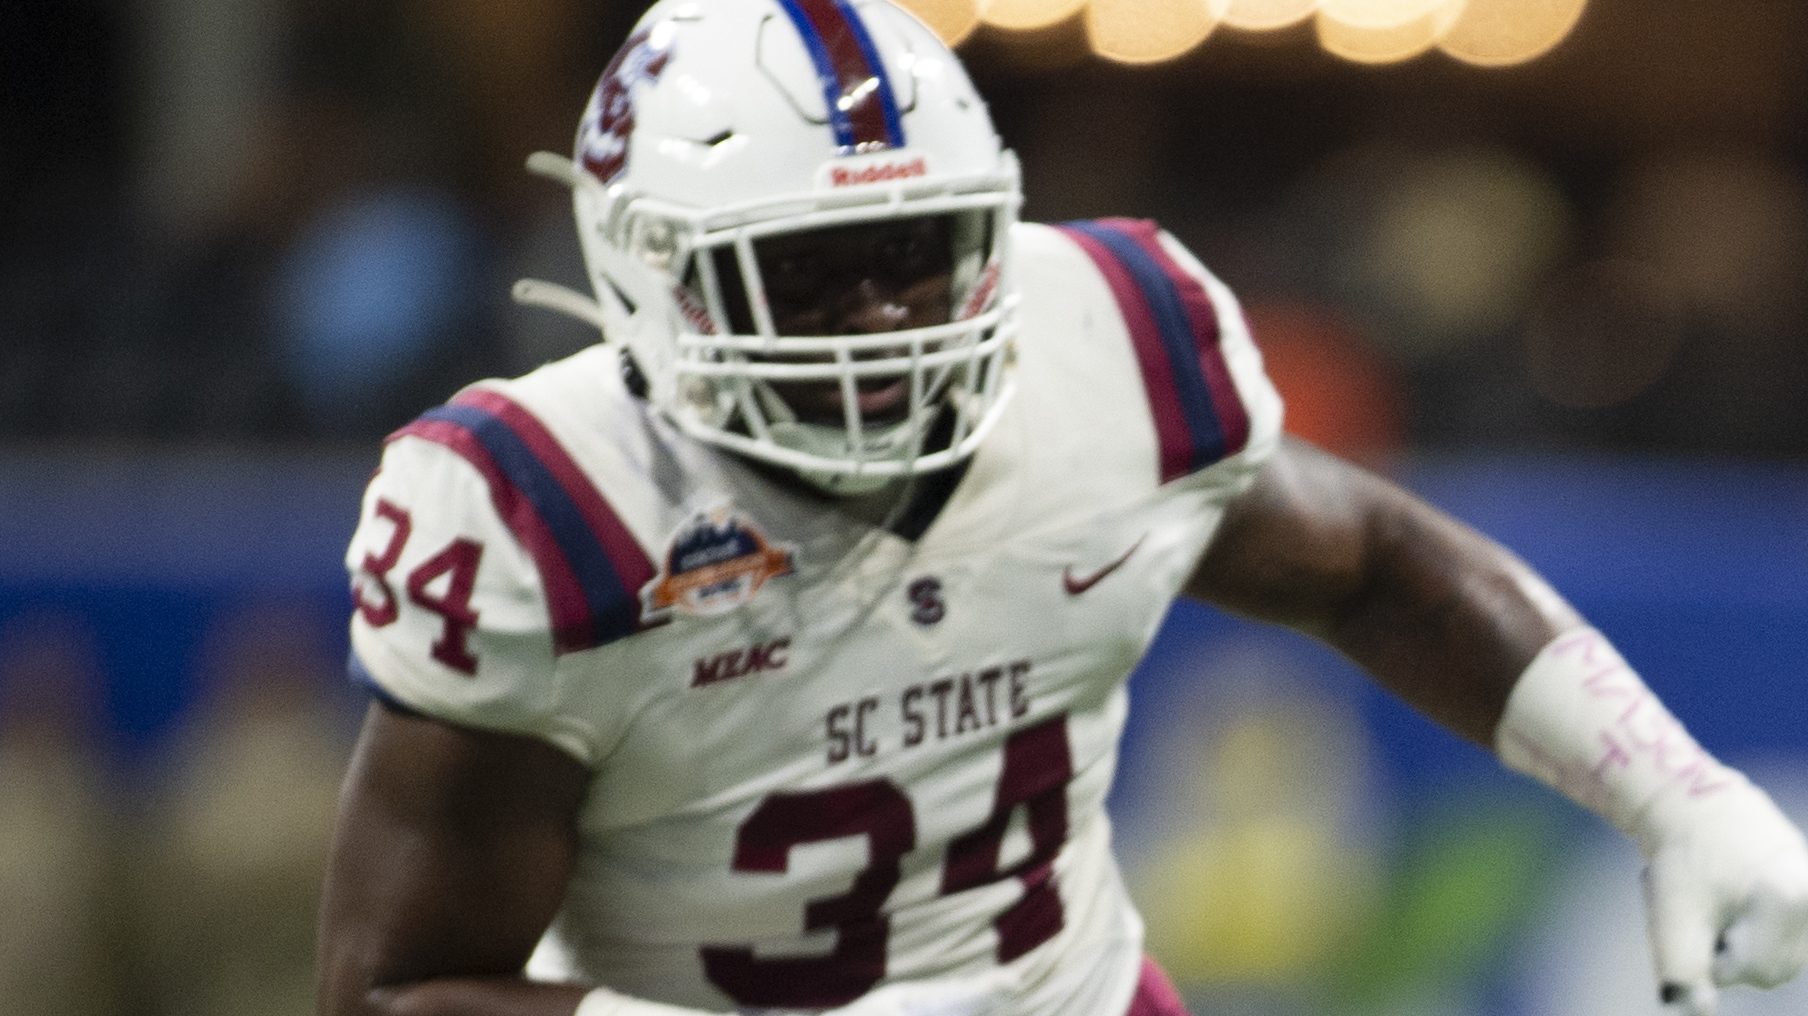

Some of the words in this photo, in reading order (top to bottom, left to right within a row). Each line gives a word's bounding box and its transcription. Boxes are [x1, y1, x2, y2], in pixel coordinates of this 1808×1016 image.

[352, 497, 485, 678] 34
[690, 634, 791, 688] MEAC
[826, 698, 879, 765] SC
[901, 660, 1032, 747] STATE
[698, 708, 1074, 1009] 34
